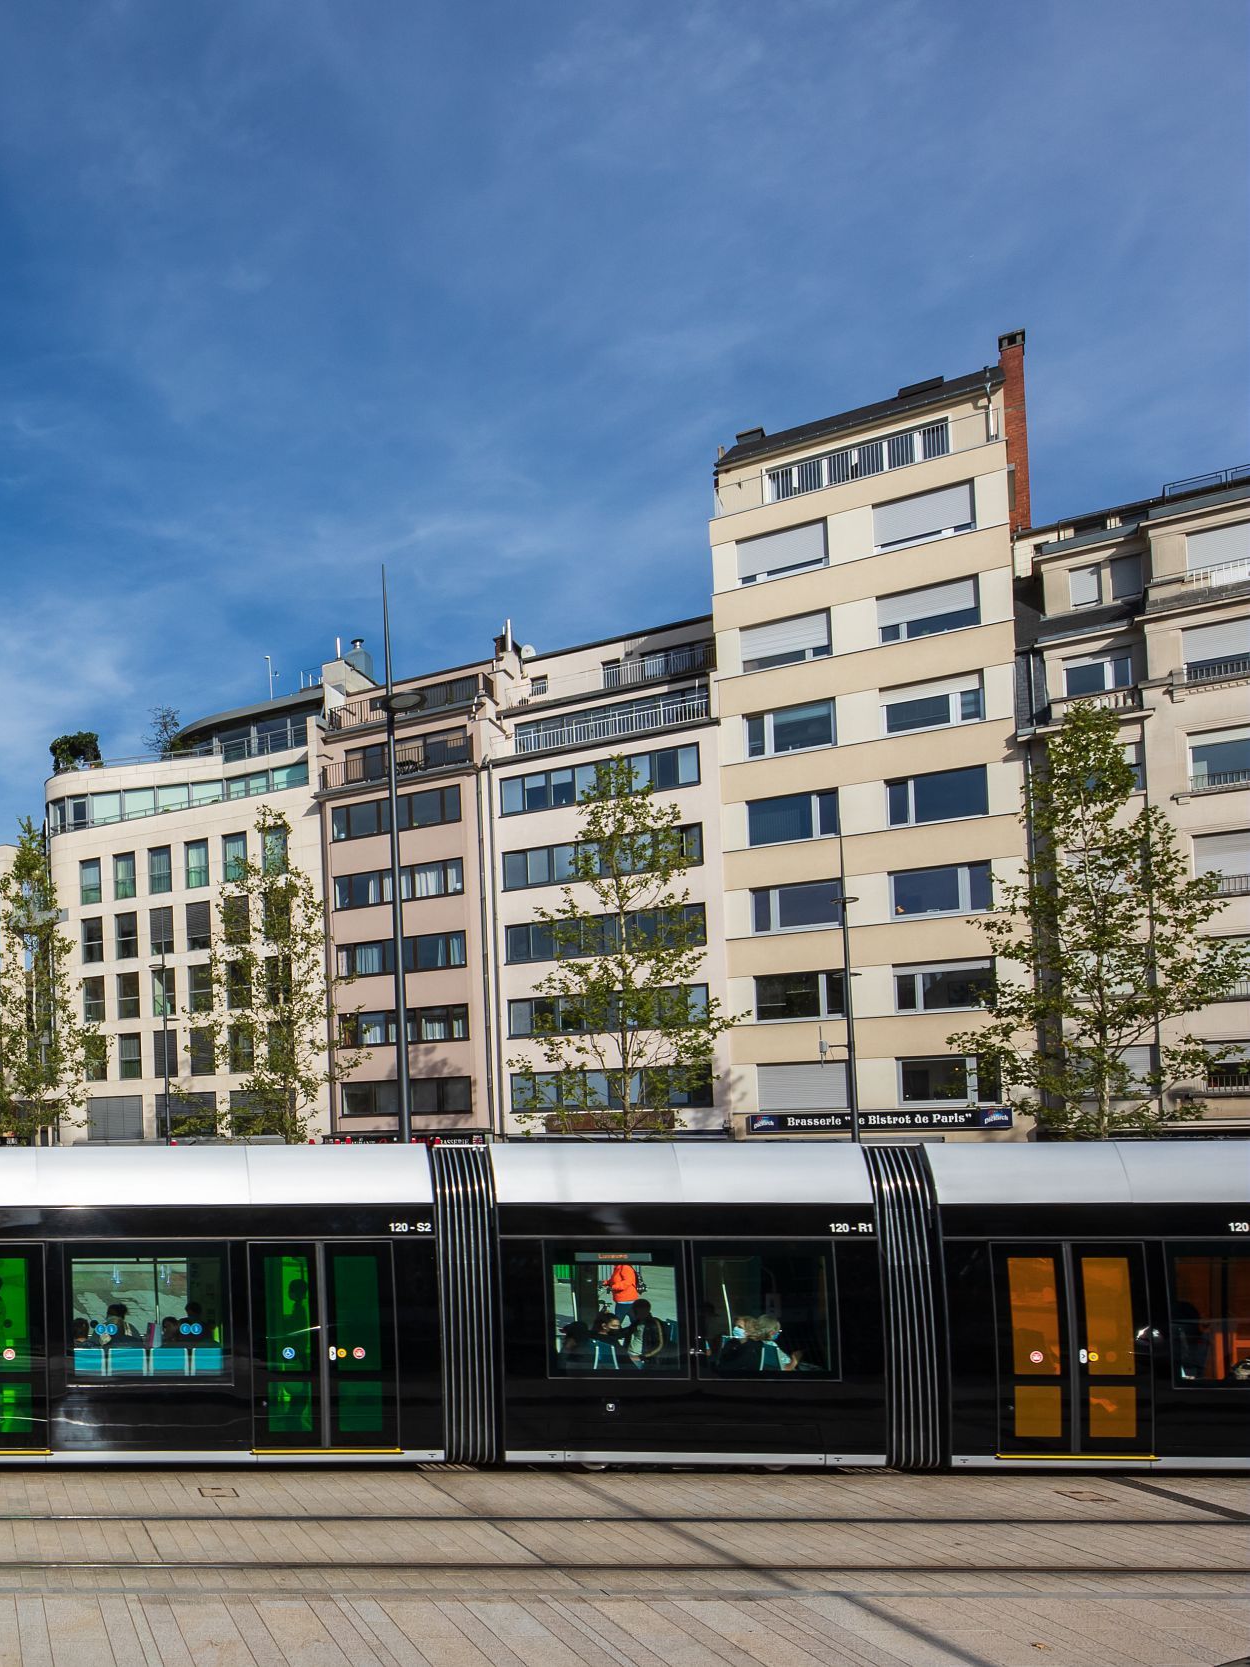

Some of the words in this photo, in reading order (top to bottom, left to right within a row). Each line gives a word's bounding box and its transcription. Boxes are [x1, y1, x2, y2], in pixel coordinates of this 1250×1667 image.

[787, 1115, 842, 1126] Brasserie
[868, 1114, 911, 1125] Bistrot
[914, 1114, 929, 1124] de
[389, 1222, 409, 1232] 120
[416, 1222, 432, 1232] S2
[829, 1223, 850, 1233] 120
[858, 1223, 873, 1233] R1
[1228, 1222, 1250, 1232] 120
